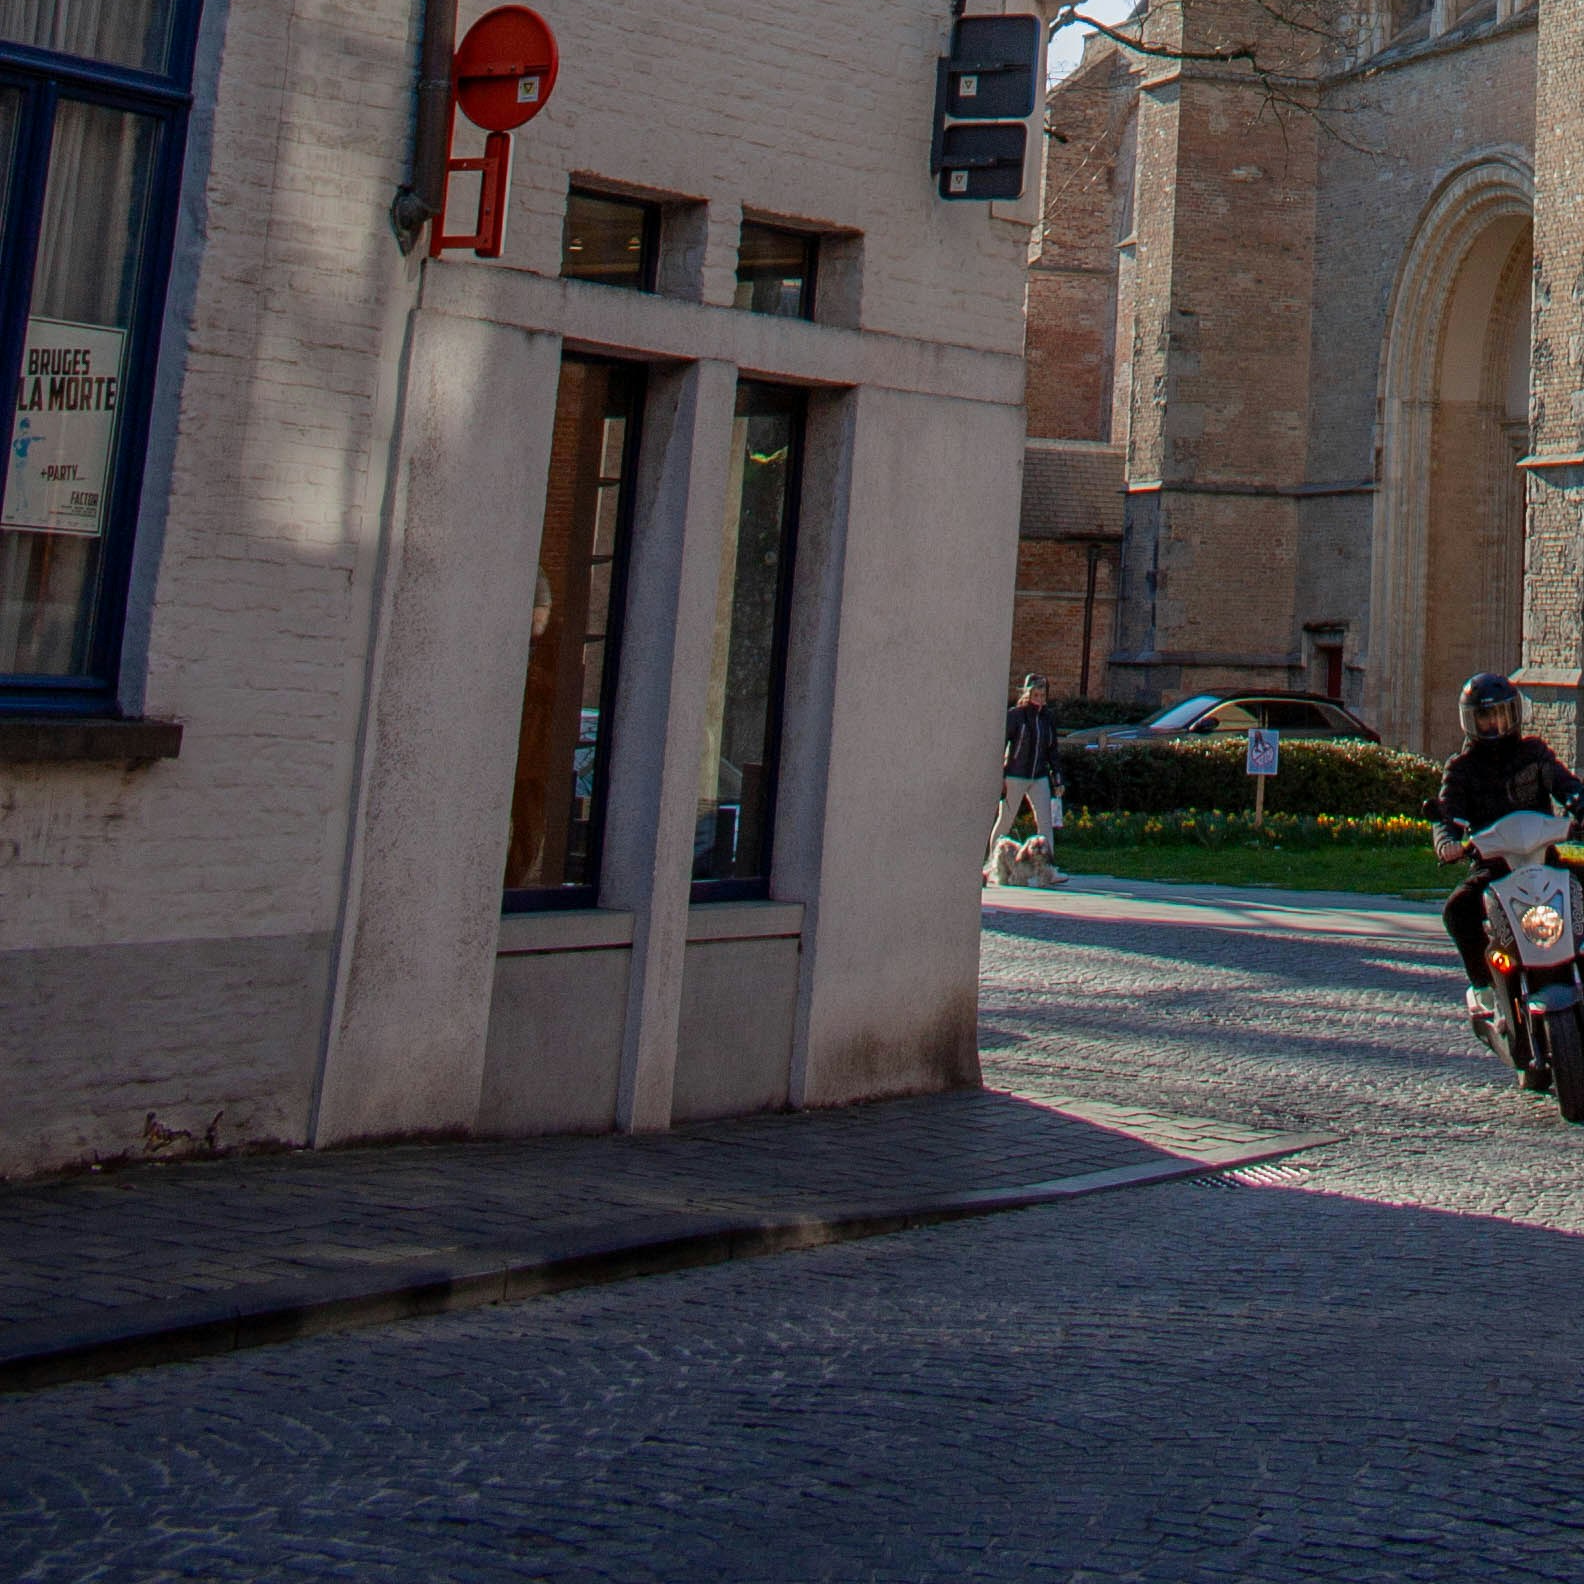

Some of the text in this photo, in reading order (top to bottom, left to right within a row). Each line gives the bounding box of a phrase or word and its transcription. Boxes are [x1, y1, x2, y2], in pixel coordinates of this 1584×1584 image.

[28, 348, 91, 376] BRUGES
[17, 376, 117, 412] LA MORTE
